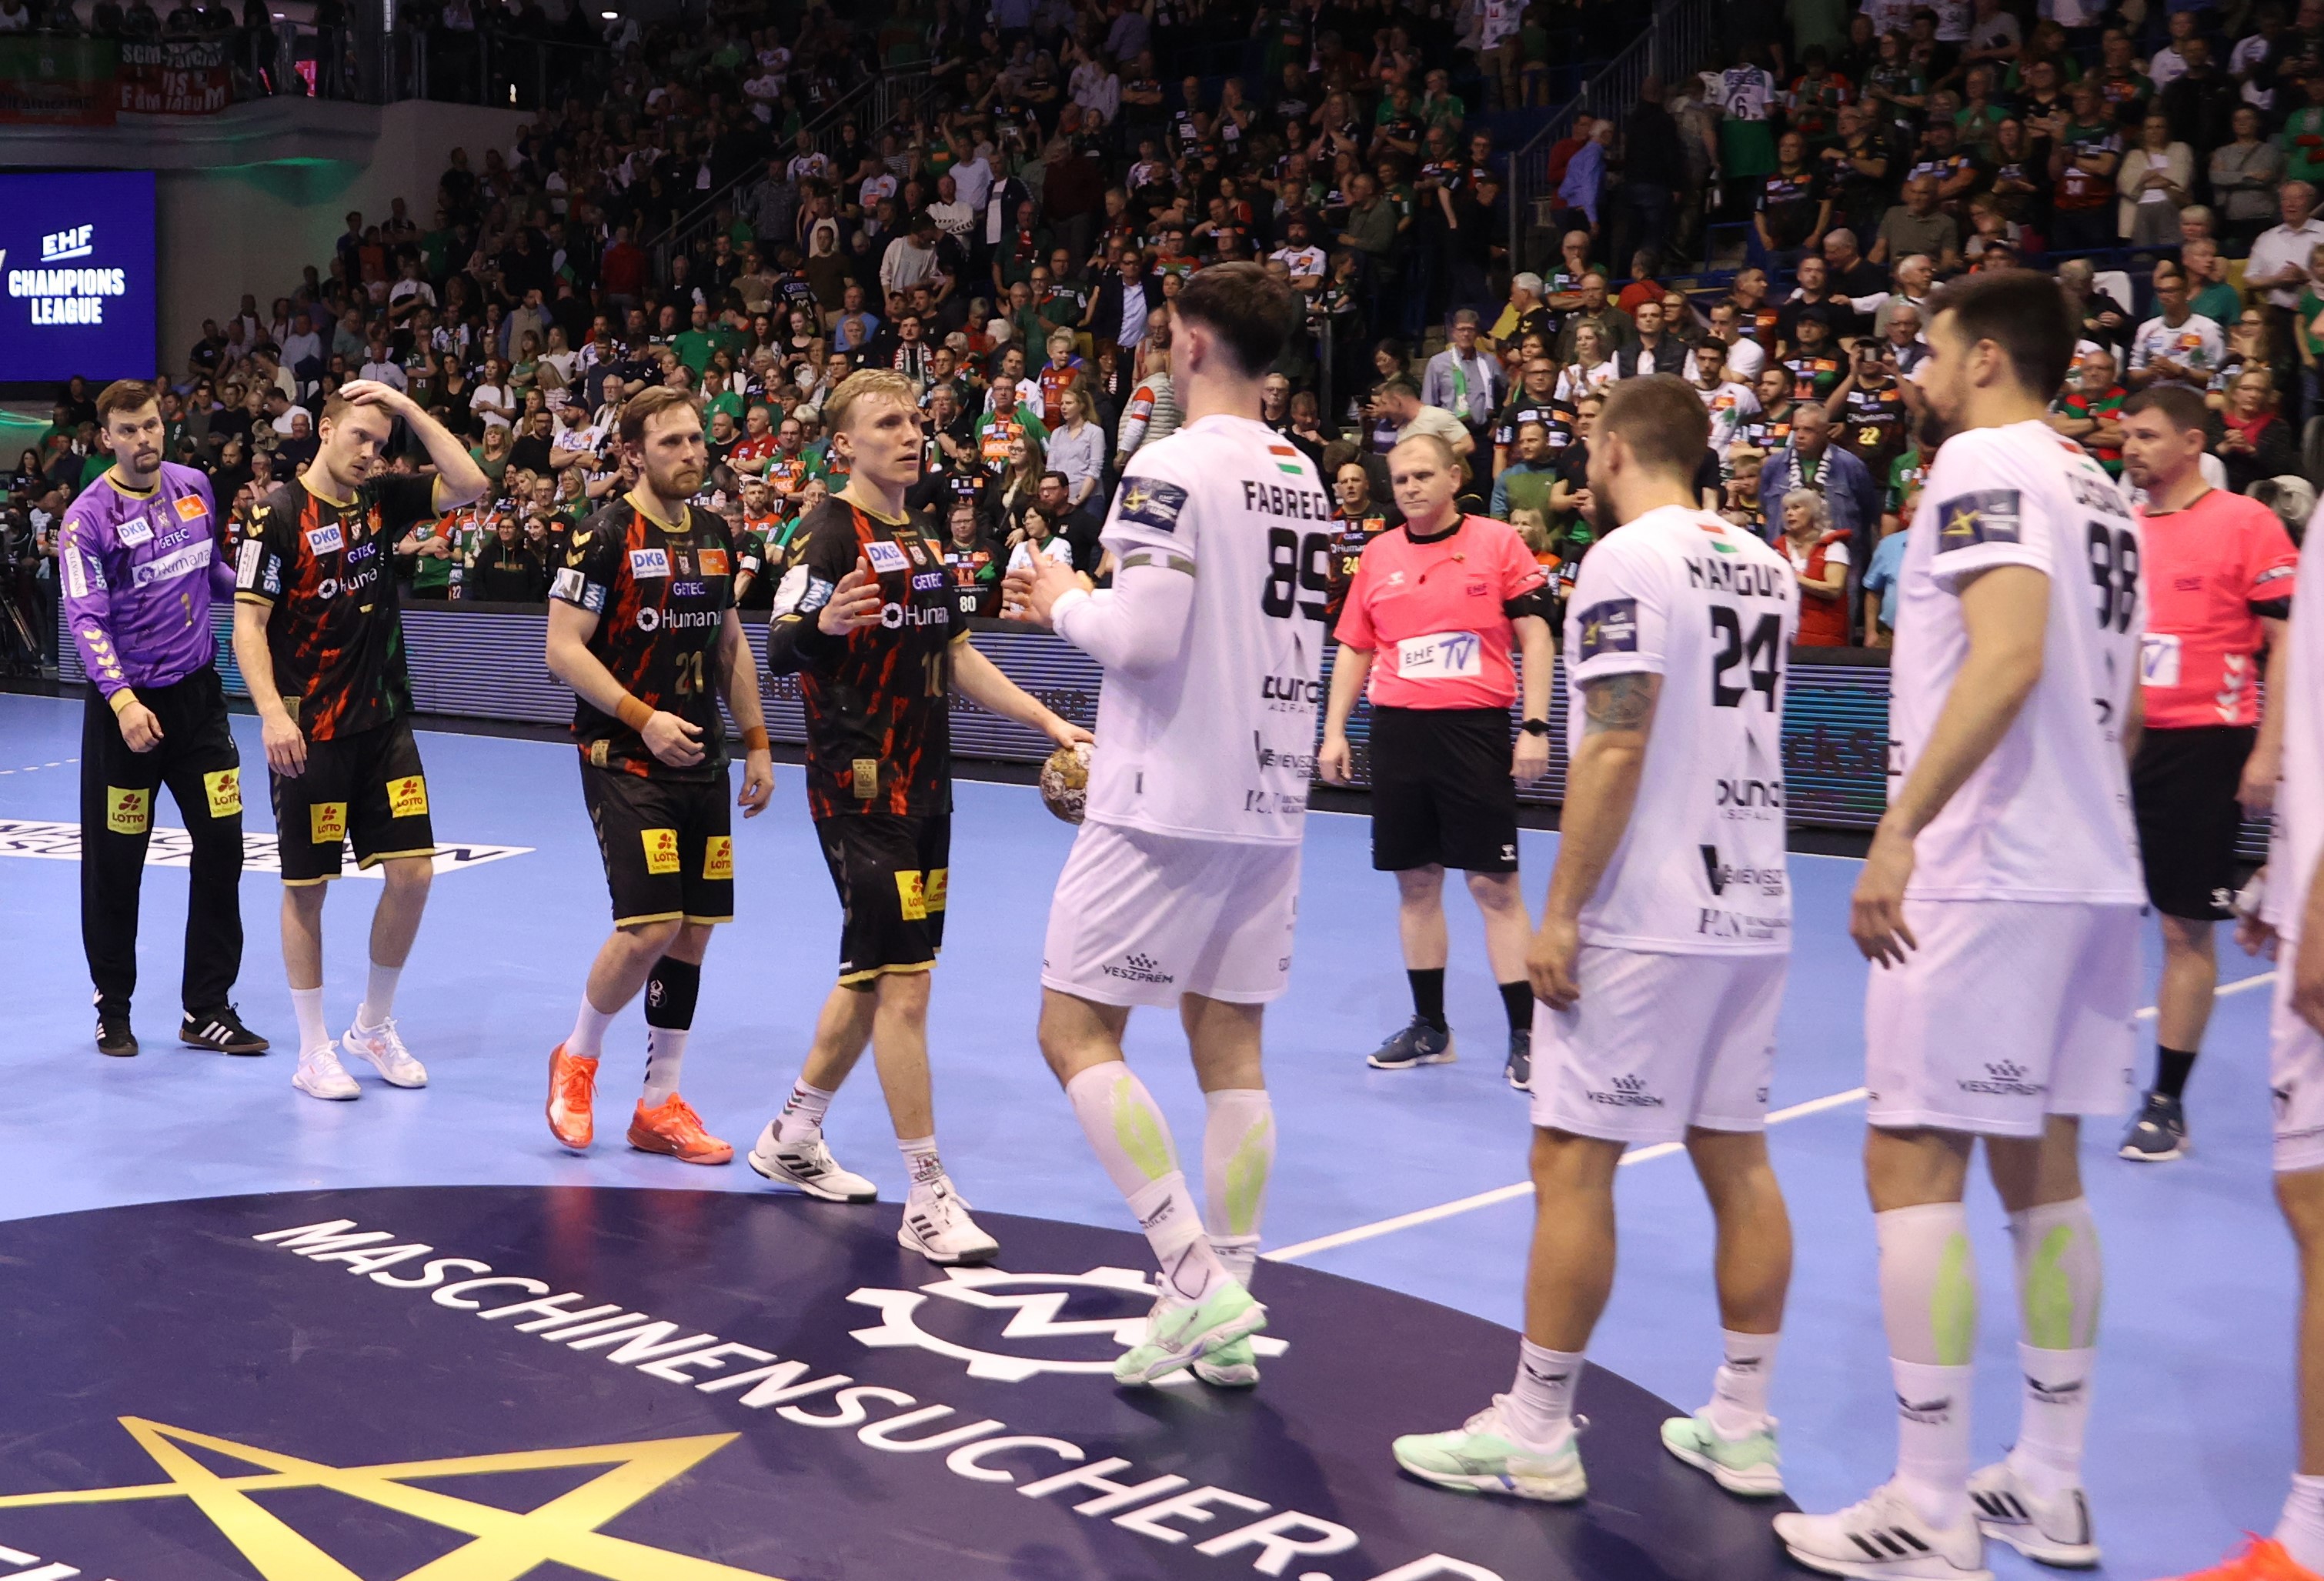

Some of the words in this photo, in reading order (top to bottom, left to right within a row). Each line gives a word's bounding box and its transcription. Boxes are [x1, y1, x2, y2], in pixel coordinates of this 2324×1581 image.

[43, 225, 92, 256] EHF
[8, 269, 125, 297] CHAMPIONS
[32, 298, 102, 325] LEAGUE
[120, 521, 146, 539] DKB
[159, 528, 190, 549] GETEC
[311, 528, 340, 545] DKB
[633, 552, 665, 567] DKB
[870, 545, 900, 561] DKB
[673, 582, 706, 595] GETEC
[913, 572, 943, 590] GETEC
[959, 595, 976, 613] 80
[1406, 645, 1434, 664] EHF
[1438, 635, 1475, 670] TV
[1709, 605, 1782, 712] 24
[675, 651, 704, 695] 21
[396, 797, 422, 807] LOTTO
[112, 812, 145, 822] LOTTO
[317, 824, 341, 834] LOTTO
